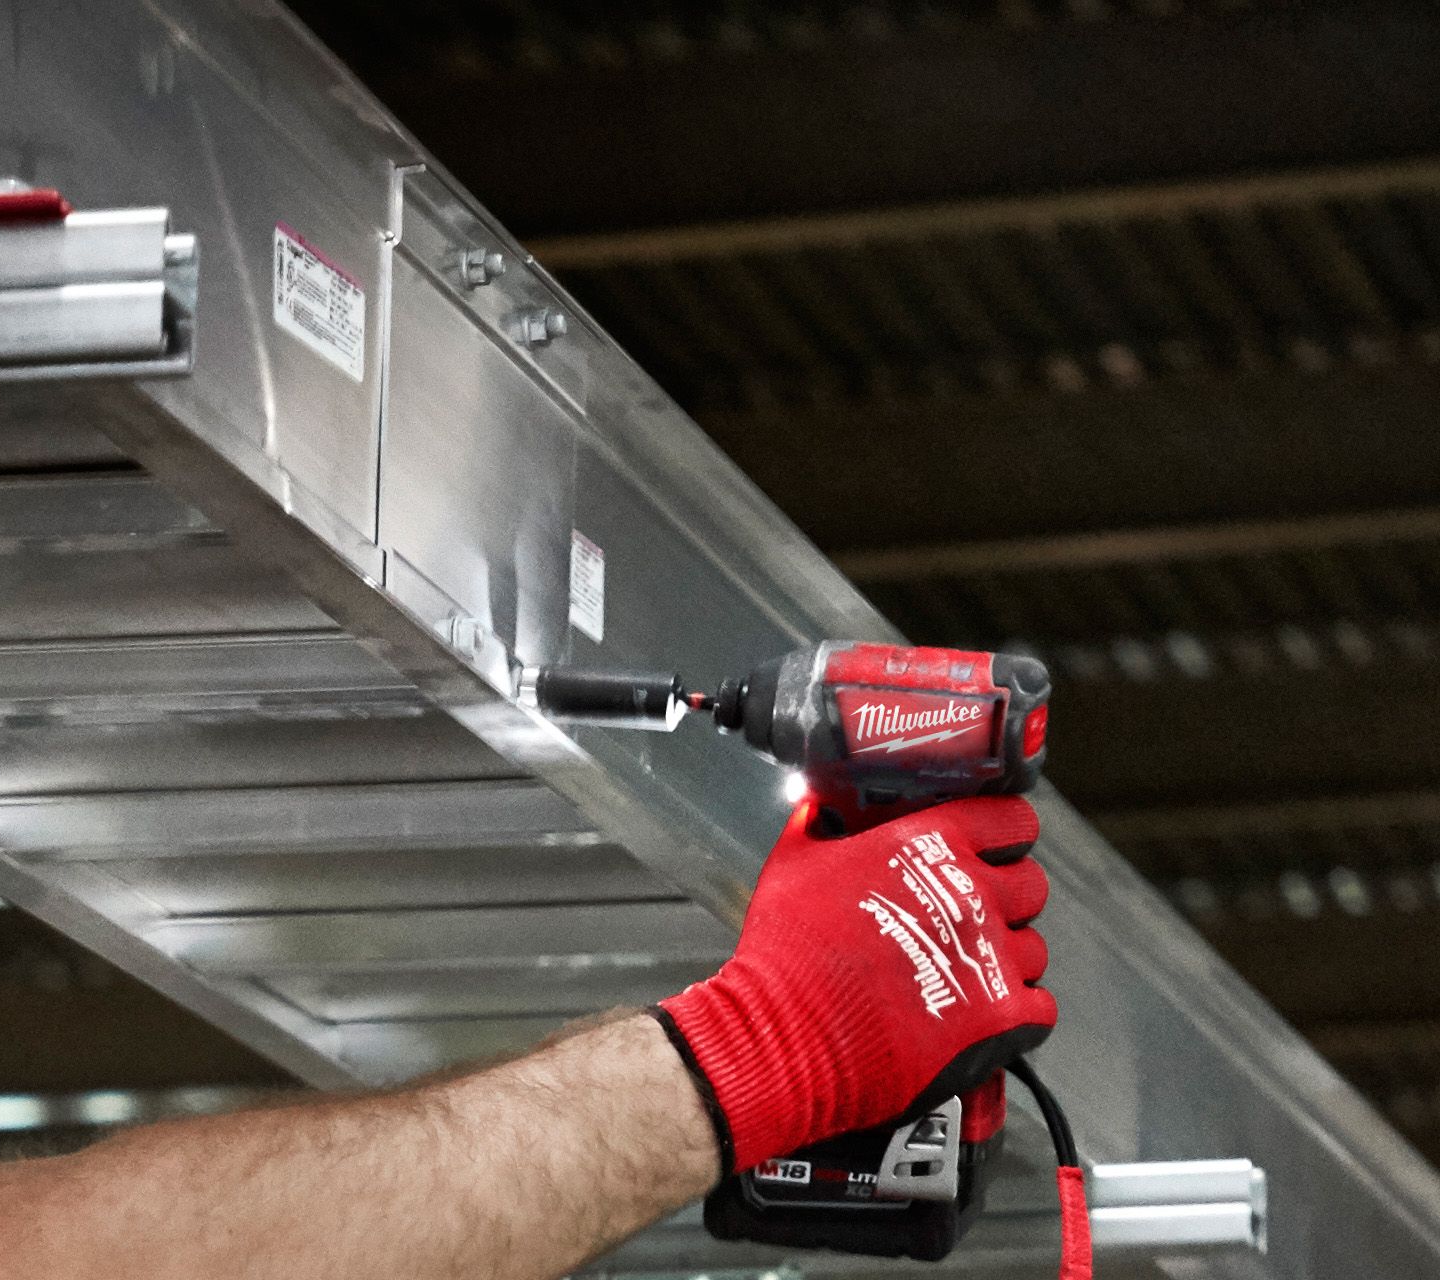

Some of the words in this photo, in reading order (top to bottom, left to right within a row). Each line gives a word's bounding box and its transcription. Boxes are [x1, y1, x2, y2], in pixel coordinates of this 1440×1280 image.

[850, 700, 983, 741] Milwaukee
[931, 915, 951, 944] CUT
[864, 898, 957, 1020] Milwaukee
[757, 1160, 807, 1179] M18
